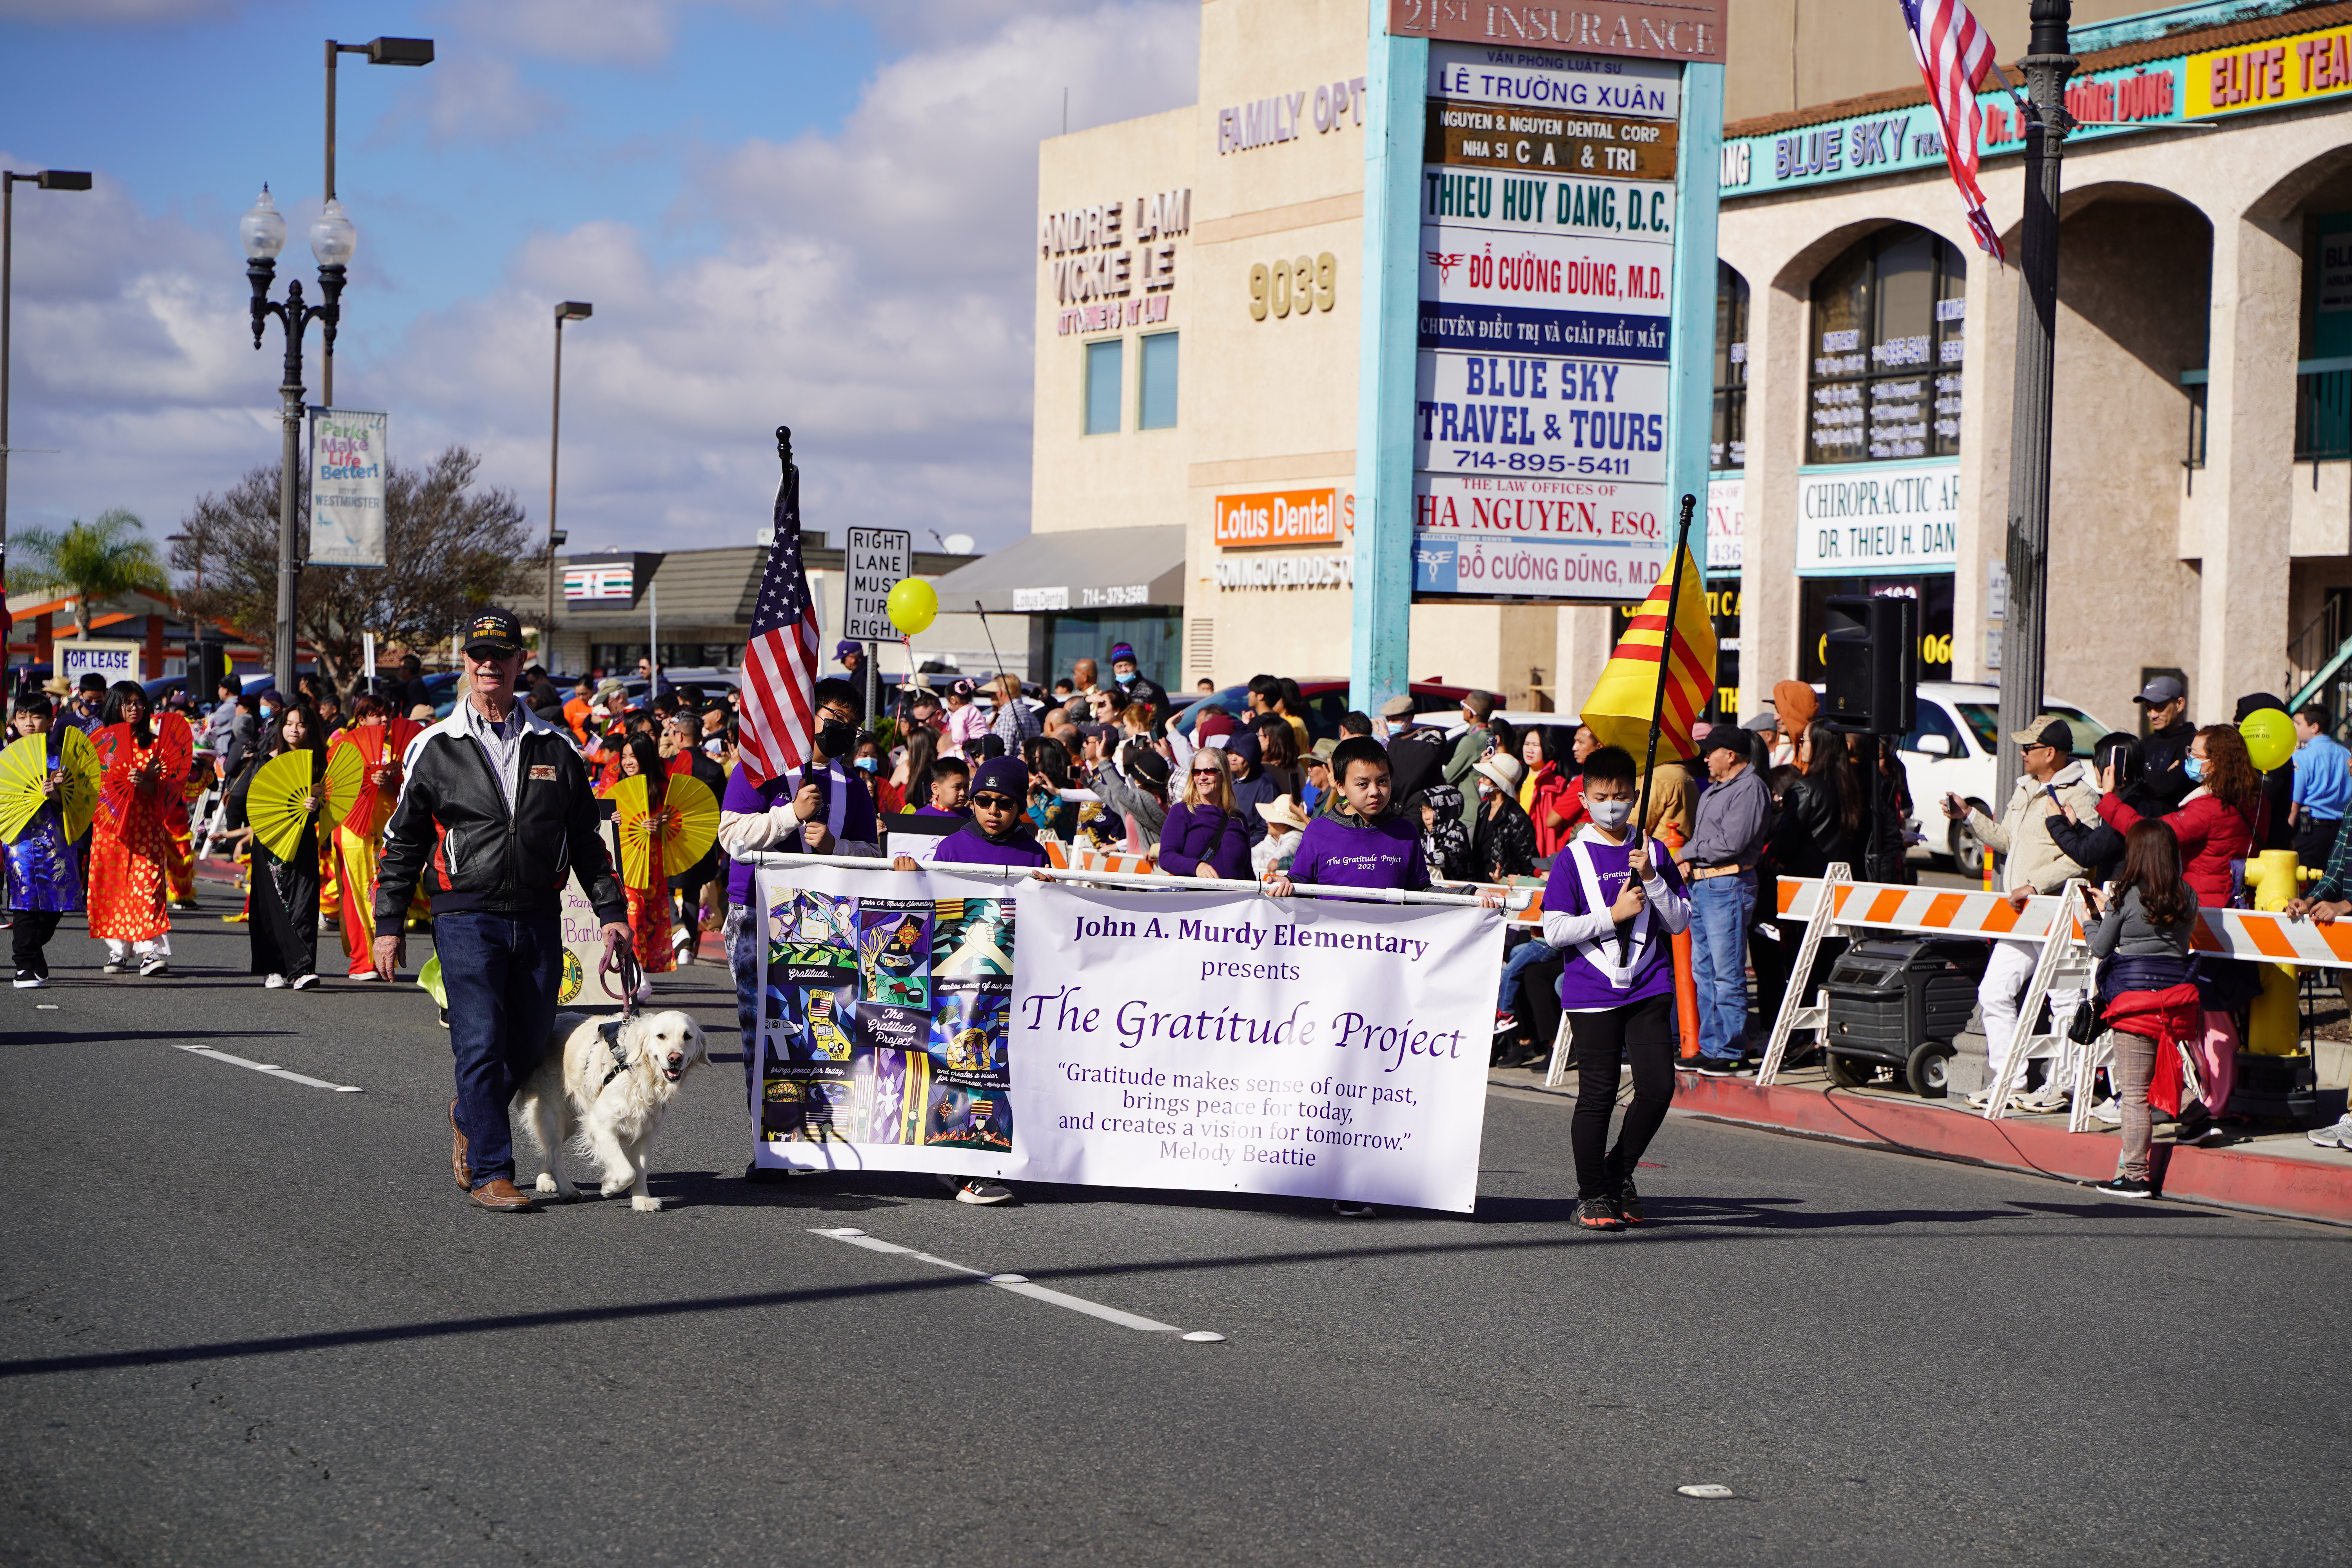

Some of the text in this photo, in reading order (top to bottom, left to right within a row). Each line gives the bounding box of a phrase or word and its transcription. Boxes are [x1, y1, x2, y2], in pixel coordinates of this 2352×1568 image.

[1485, 3, 1716, 55] INSURANCE
[1517, 53, 1564, 70] PHÒNG
[1604, 62, 1622, 75] SƯ
[2210, 32, 2352, 107] ELITE TEA
[1439, 67, 1665, 111] LÊ TRƯỜNG XUÂN
[1218, 77, 1368, 155] FAMILY OPT
[1439, 111, 1661, 143] NGUYEN & NGUYEN DENTAL CORP.
[1985, 103, 2012, 146] Dr.
[1462, 140, 1637, 172] NHA SI C A & TRI
[1775, 127, 1842, 179] BLUE
[1849, 116, 1909, 167] SKY
[1911, 129, 1945, 157] TRA
[1426, 172, 1670, 233] THIEU HUY DANG, D.C.
[1041, 188, 1191, 255] ANDRE LAM
[1049, 243, 1175, 304] VICKIE LE
[1469, 242, 1664, 301] ĐỖ CƯỜNG DŨNG, M.D.
[1250, 252, 1335, 321] 9039
[1058, 294, 1170, 334] ATTORNEYS AT LAW
[1420, 315, 1475, 337] CHUYÊN
[1479, 313, 1512, 339] ĐIỀU
[1517, 323, 1539, 345] TRỊ
[1544, 321, 1561, 342] VÀ
[1565, 320, 1594, 345] GIẢI
[1637, 323, 1666, 348] MẮT
[1466, 357, 1619, 402] BLUE SKY
[322, 421, 369, 441] Parks
[1418, 401, 1662, 452] TRAVEL & TOURS
[321, 437, 369, 454] Make
[329, 450, 361, 468] Life
[321, 463, 378, 480] Better!
[1453, 450, 1630, 475] 714-895-5411
[1462, 477, 1618, 496] THE LAW OFFICES OF
[1726, 486, 1739, 498] OF
[1806, 476, 1932, 518] CHIROPRACTIC
[316, 494, 379, 508] WESTMINSTER
[1217, 493, 1334, 539] Lotus Dental
[1416, 495, 1661, 539] HA NGUYEN, ESQ.
[854, 532, 903, 550] RIGHT
[1819, 523, 1955, 558] DR. THIEU H. DAN
[856, 554, 900, 572] LANE
[1458, 544, 1622, 586] ĐỖ CƯỜNG DŨNG,
[855, 598, 887, 615] TUR
[473, 630, 507, 638] VIETNAM VETERAN
[64, 651, 128, 668] FOR LEASE
[1327, 853, 1401, 866] The Gratitude Project
[1602, 868, 1632, 881] Gratitud
[1074, 916, 1430, 962] John A. Murdy Elementary
[564, 950, 581, 968] ARMY
[1201, 960, 1300, 980] presents
[788, 968, 835, 980] Gratitude...
[938, 982, 961, 991] makes
[981, 981, 991, 991] of
[812, 990, 833, 999] FREEDOM
[867, 1018, 916, 1033] Gratitude
[882, 1008, 904, 1020] The
[875, 1031, 913, 1047] Project
[1022, 985, 1468, 1073] The Gratitude Project
[770, 1066, 791, 1075] brings
[809, 1067, 824, 1077] for
[824, 1067, 845, 1076] today,
[935, 1074, 982, 1087] for tomorrow.
[1058, 1062, 1417, 1107] “Gratitude makes sense of our past,
[1123, 1090, 1353, 1124] brings peace for today,
[1059, 1112, 1411, 1151] and creates a vision for tomorrow.”
[1160, 1141, 1316, 1166] Melody Beattie
